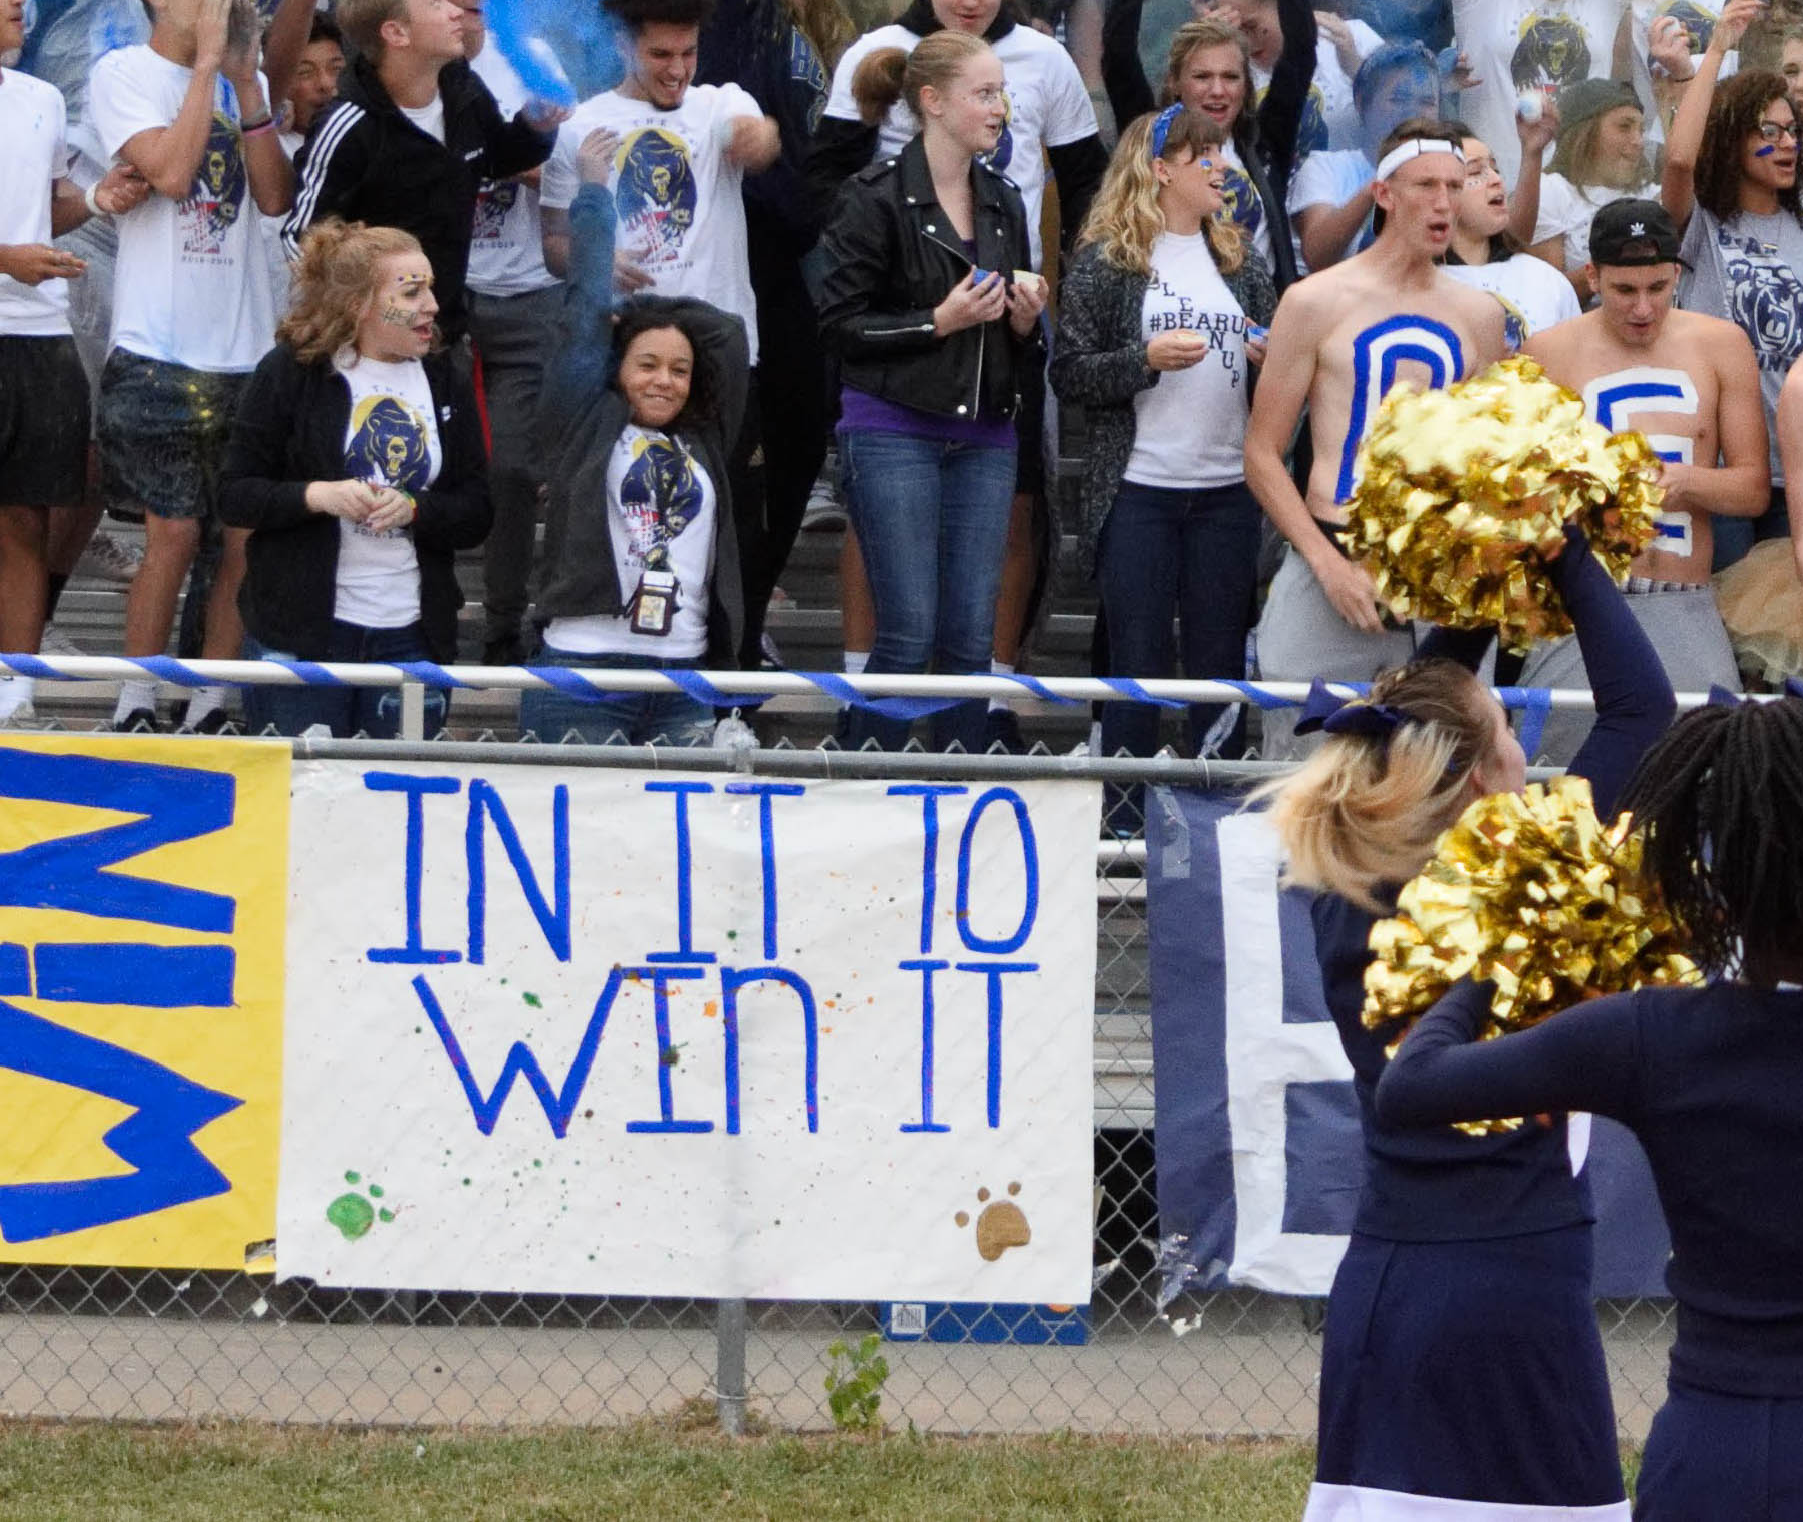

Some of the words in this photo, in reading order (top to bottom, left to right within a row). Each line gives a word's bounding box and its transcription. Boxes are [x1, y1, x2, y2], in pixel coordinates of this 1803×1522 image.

[1150, 311, 1249, 342] #BEARU
[362, 771, 571, 965] IN
[644, 780, 805, 966] IT
[887, 784, 1039, 956] TO
[898, 959, 1040, 1134] IT
